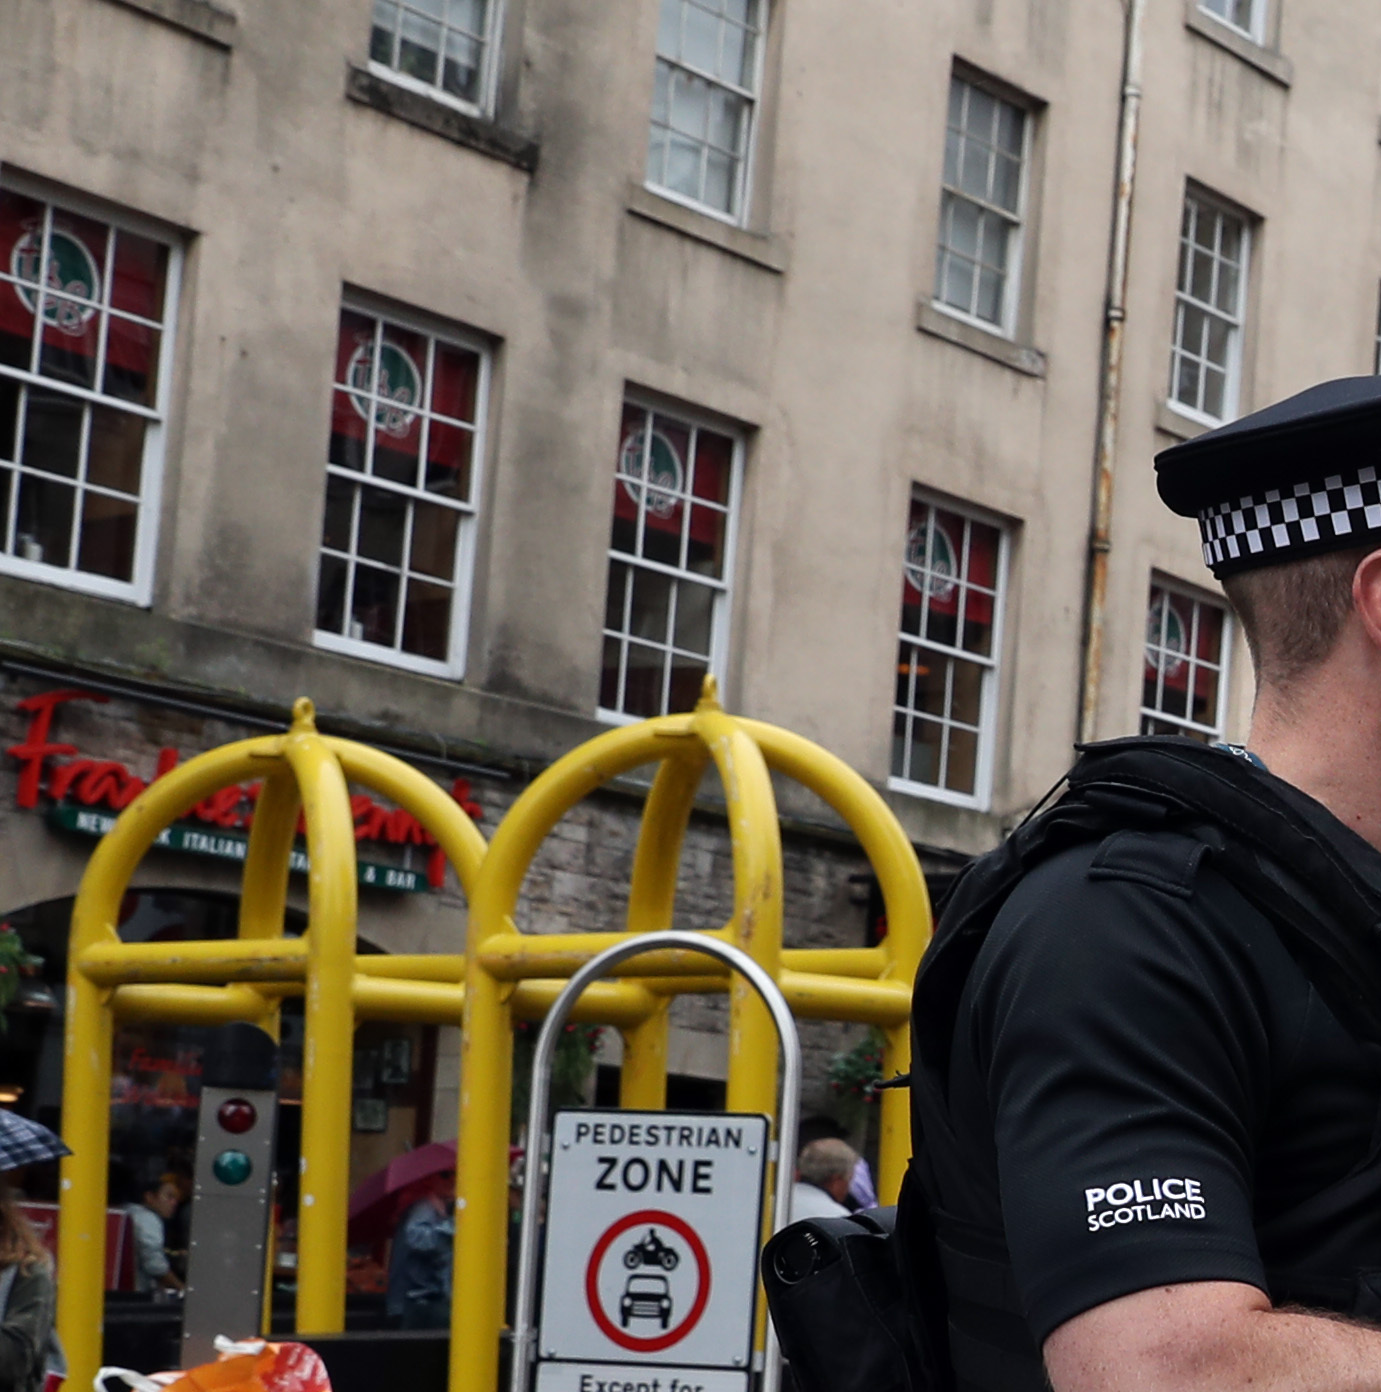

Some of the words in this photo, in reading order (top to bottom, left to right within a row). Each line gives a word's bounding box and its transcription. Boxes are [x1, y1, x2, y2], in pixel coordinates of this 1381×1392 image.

[182, 830, 247, 859] ITALIAN
[363, 866, 376, 882] &
[385, 869, 417, 889] BAR
[575, 1122, 743, 1149] PEDESTRIAN
[594, 1156, 714, 1195] ZONE
[1085, 1177, 1205, 1212] POLICE
[1087, 1203, 1206, 1232] SCOTLAND
